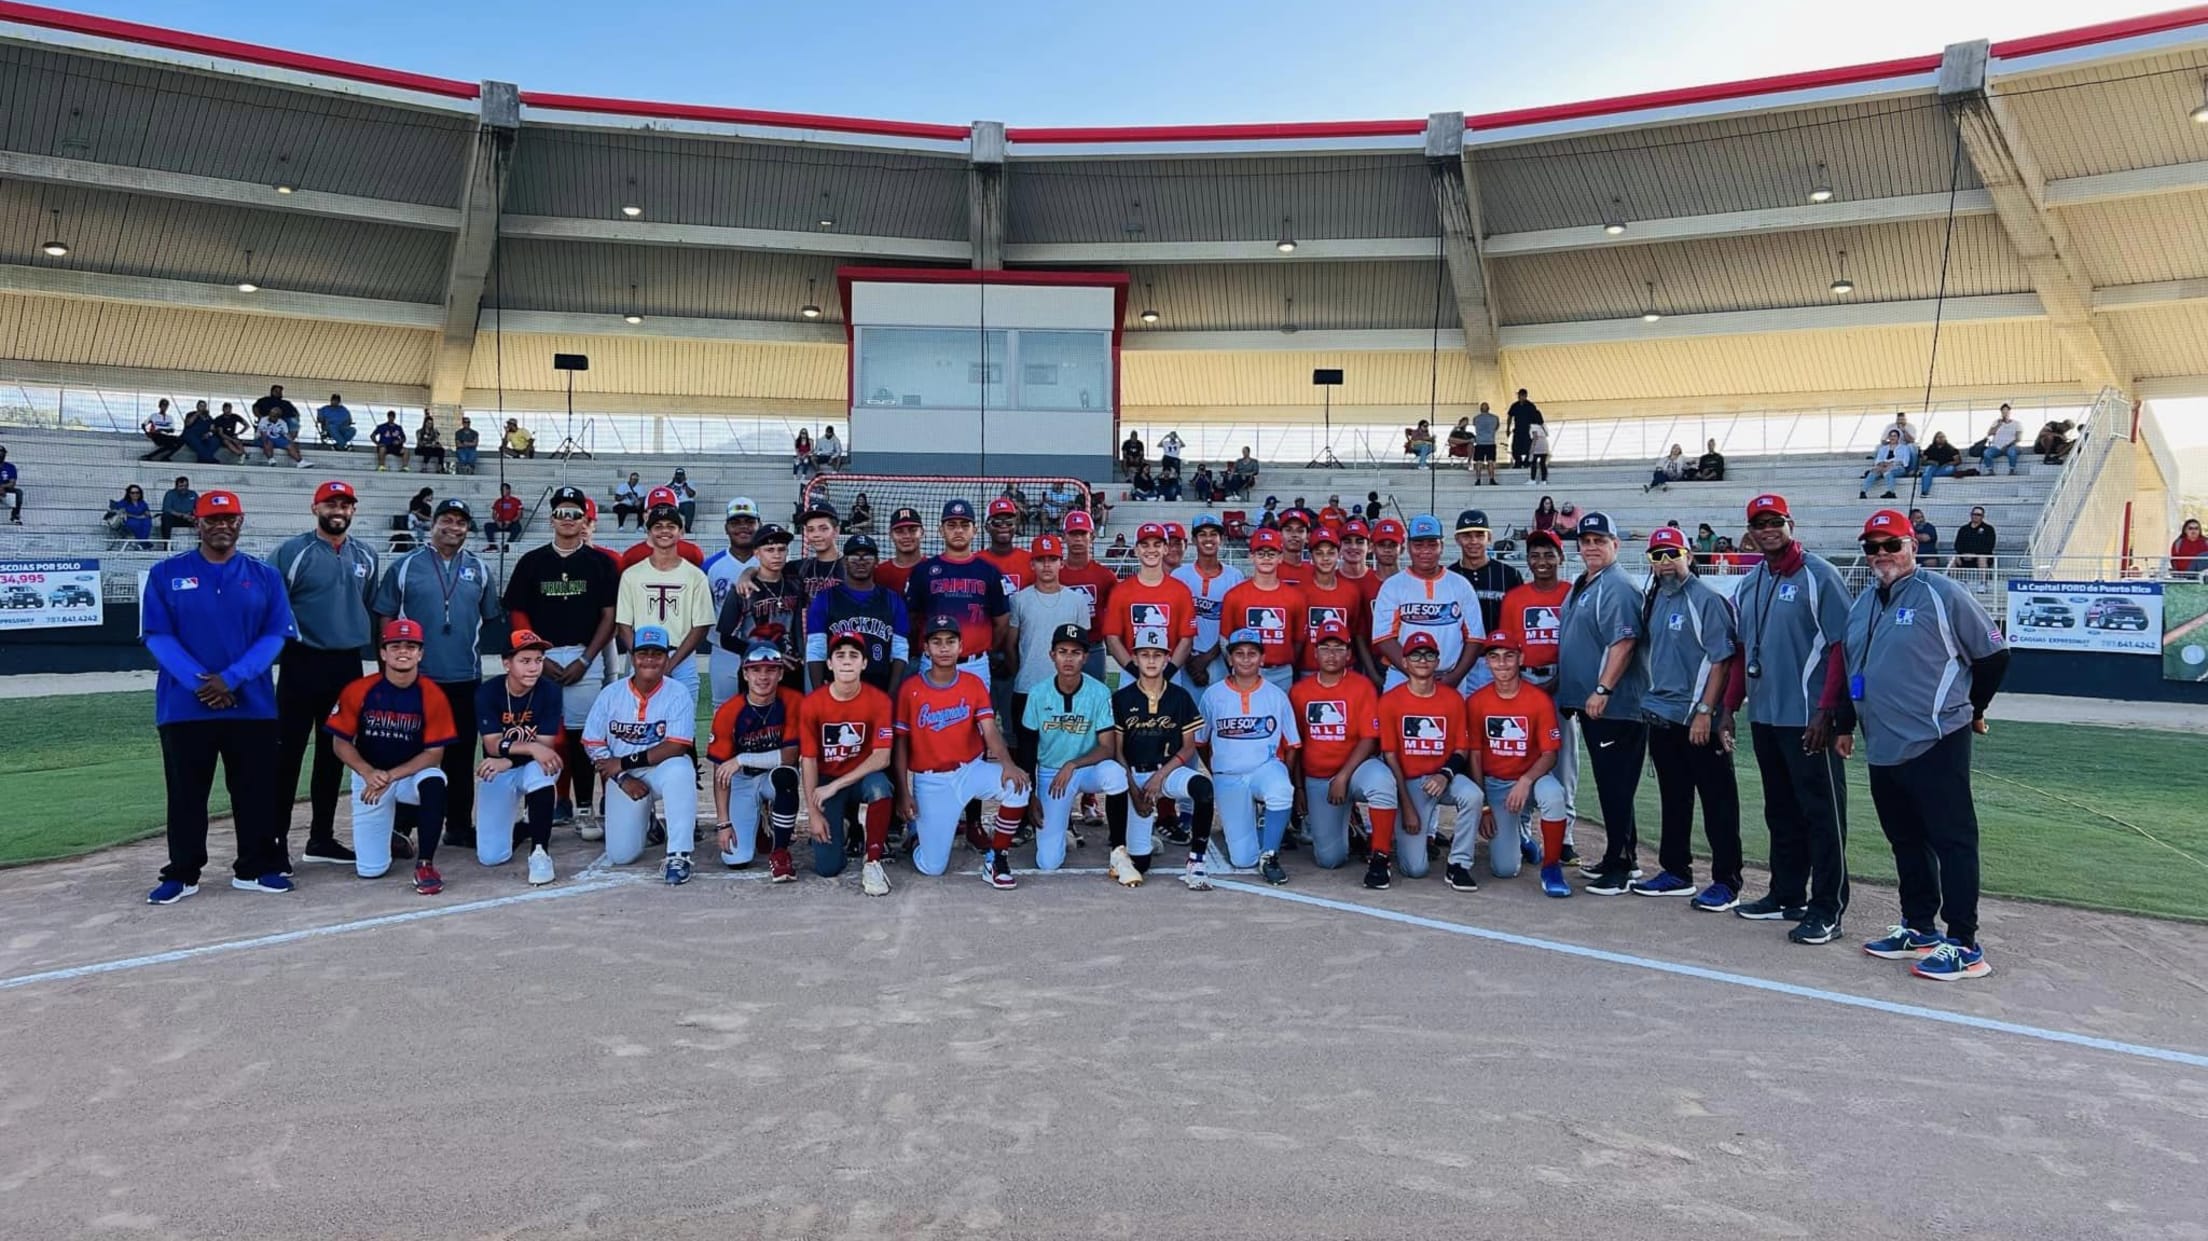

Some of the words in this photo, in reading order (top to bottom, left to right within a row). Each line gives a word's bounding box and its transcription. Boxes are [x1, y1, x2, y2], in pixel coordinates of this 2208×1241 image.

[36, 563, 55, 571] POR
[57, 562, 81, 570] SOLO
[2017, 583, 2027, 591] La
[2029, 584, 2060, 593] Capital
[2061, 584, 2086, 592] FORD
[2087, 584, 2098, 592] de
[2100, 584, 2130, 593] Puerto
[2131, 585, 2152, 593] Rico
[1421, 604, 1441, 615] SOX
[1051, 714, 1085, 722] TEAM
[1237, 718, 1257, 729] SOX
[1309, 725, 1346, 735] MLB
[1404, 739, 1445, 750] MLB
[1489, 739, 1527, 750] MLB
[824, 745, 861, 757] MLB
